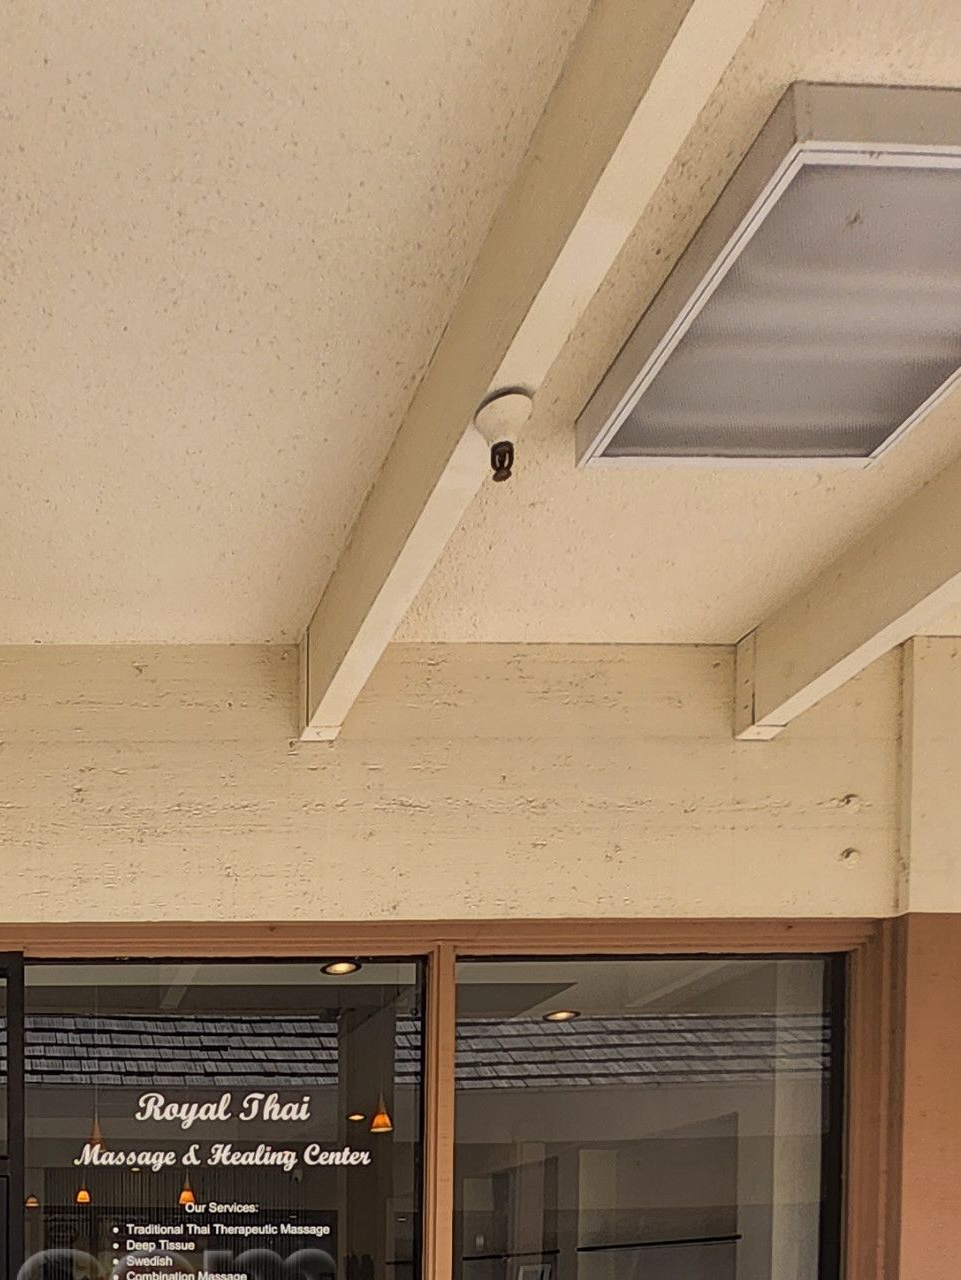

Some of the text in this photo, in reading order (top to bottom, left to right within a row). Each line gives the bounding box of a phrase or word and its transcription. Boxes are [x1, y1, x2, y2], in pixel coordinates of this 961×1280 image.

[135, 1092, 311, 1129] Royal Thai
[74, 1143, 372, 1171] Massage & Healing Center
[185, 1202, 259, 1213] Our Services:
[126, 1224, 330, 1237] Traditional Thai Therapeutic Massage
[126, 1240, 195, 1252] Deep Tissue
[126, 1256, 173, 1266] Swedish
